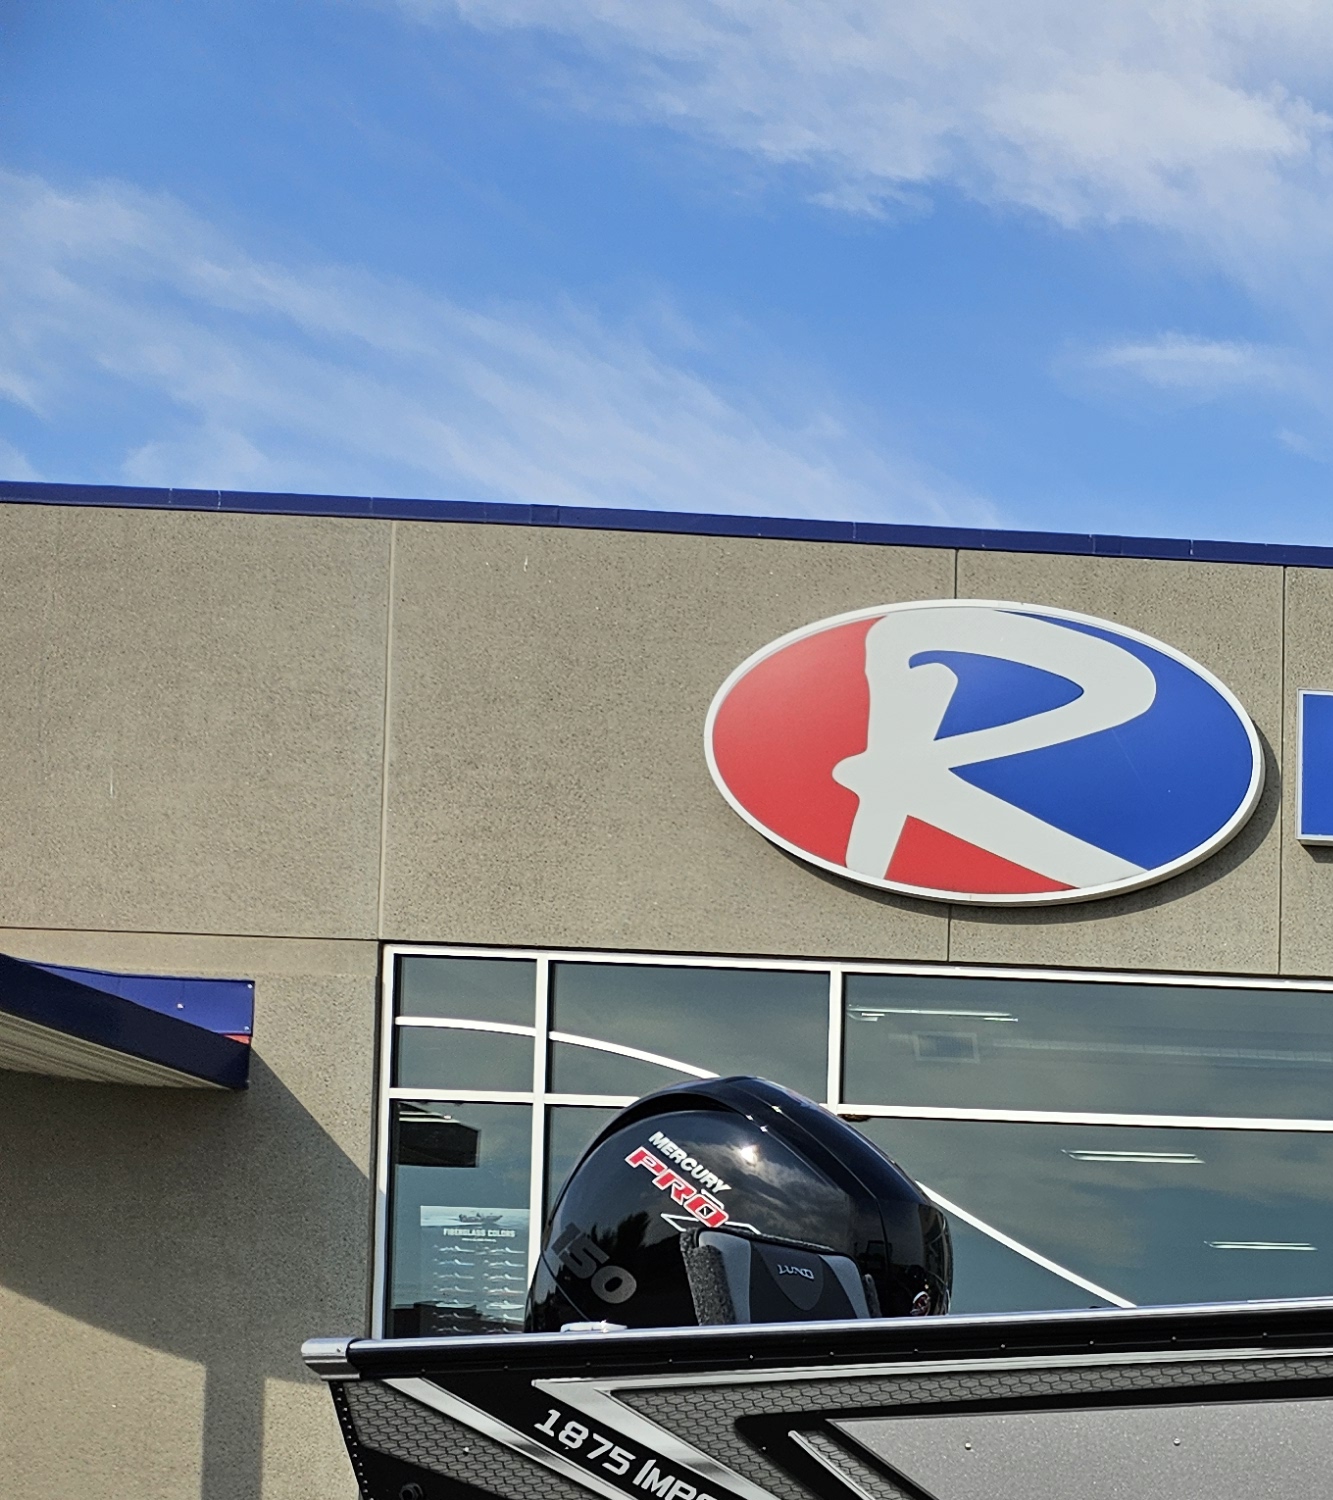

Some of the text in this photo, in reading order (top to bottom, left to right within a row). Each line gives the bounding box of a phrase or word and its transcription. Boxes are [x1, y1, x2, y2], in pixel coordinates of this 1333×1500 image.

[624, 1146, 730, 1228] PRO
[648, 1131, 732, 1194] MERCURY
[550, 1222, 637, 1304] 150
[533, 1409, 637, 1476] 1875
